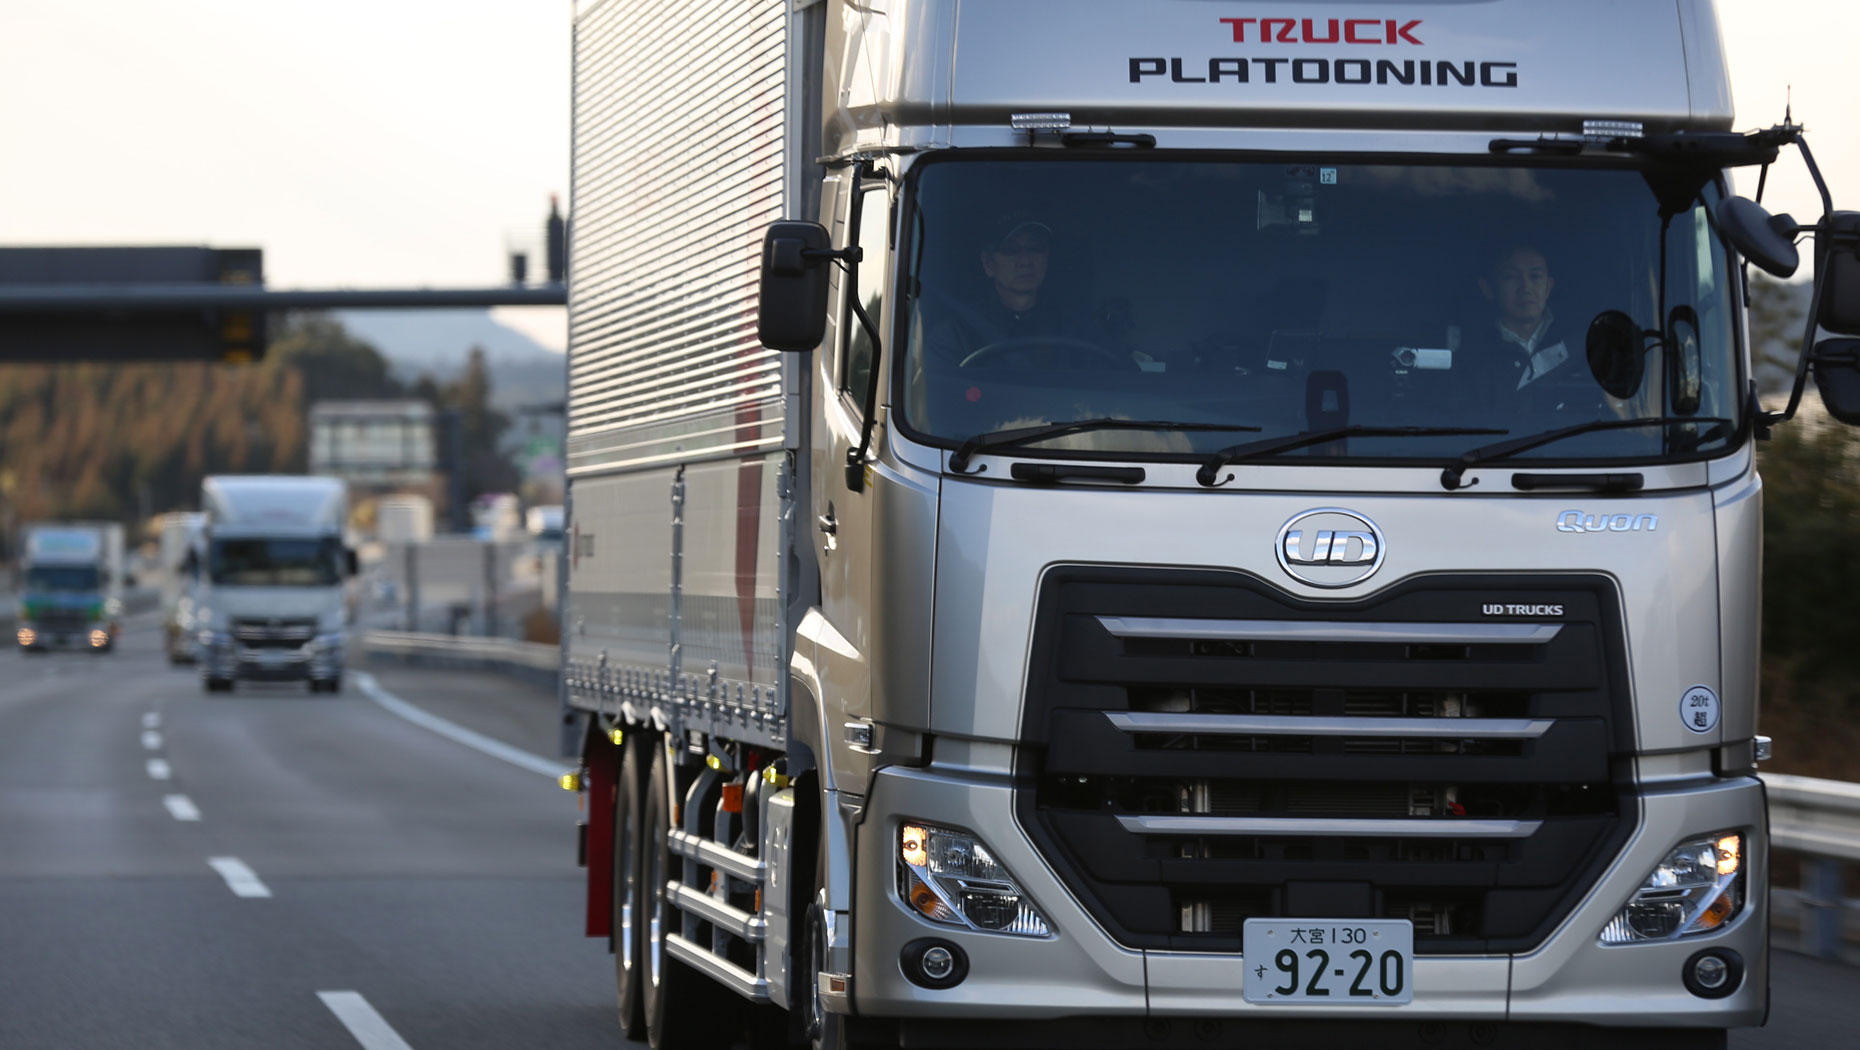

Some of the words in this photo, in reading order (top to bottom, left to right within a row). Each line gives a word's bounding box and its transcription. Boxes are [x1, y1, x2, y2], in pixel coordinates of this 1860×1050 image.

[1219, 17, 1425, 46] TRUCK
[1128, 57, 1518, 88] PLATOONING
[1556, 509, 1659, 533] Quon
[1285, 530, 1378, 566] UD
[1482, 604, 1504, 615] UD
[1506, 604, 1564, 616] TRUCKS
[1690, 695, 1710, 707] 20t
[1290, 928, 1325, 944] 大宮
[1331, 928, 1367, 944] 130
[1254, 964, 1268, 981] す
[1274, 948, 1404, 997] 92-20
